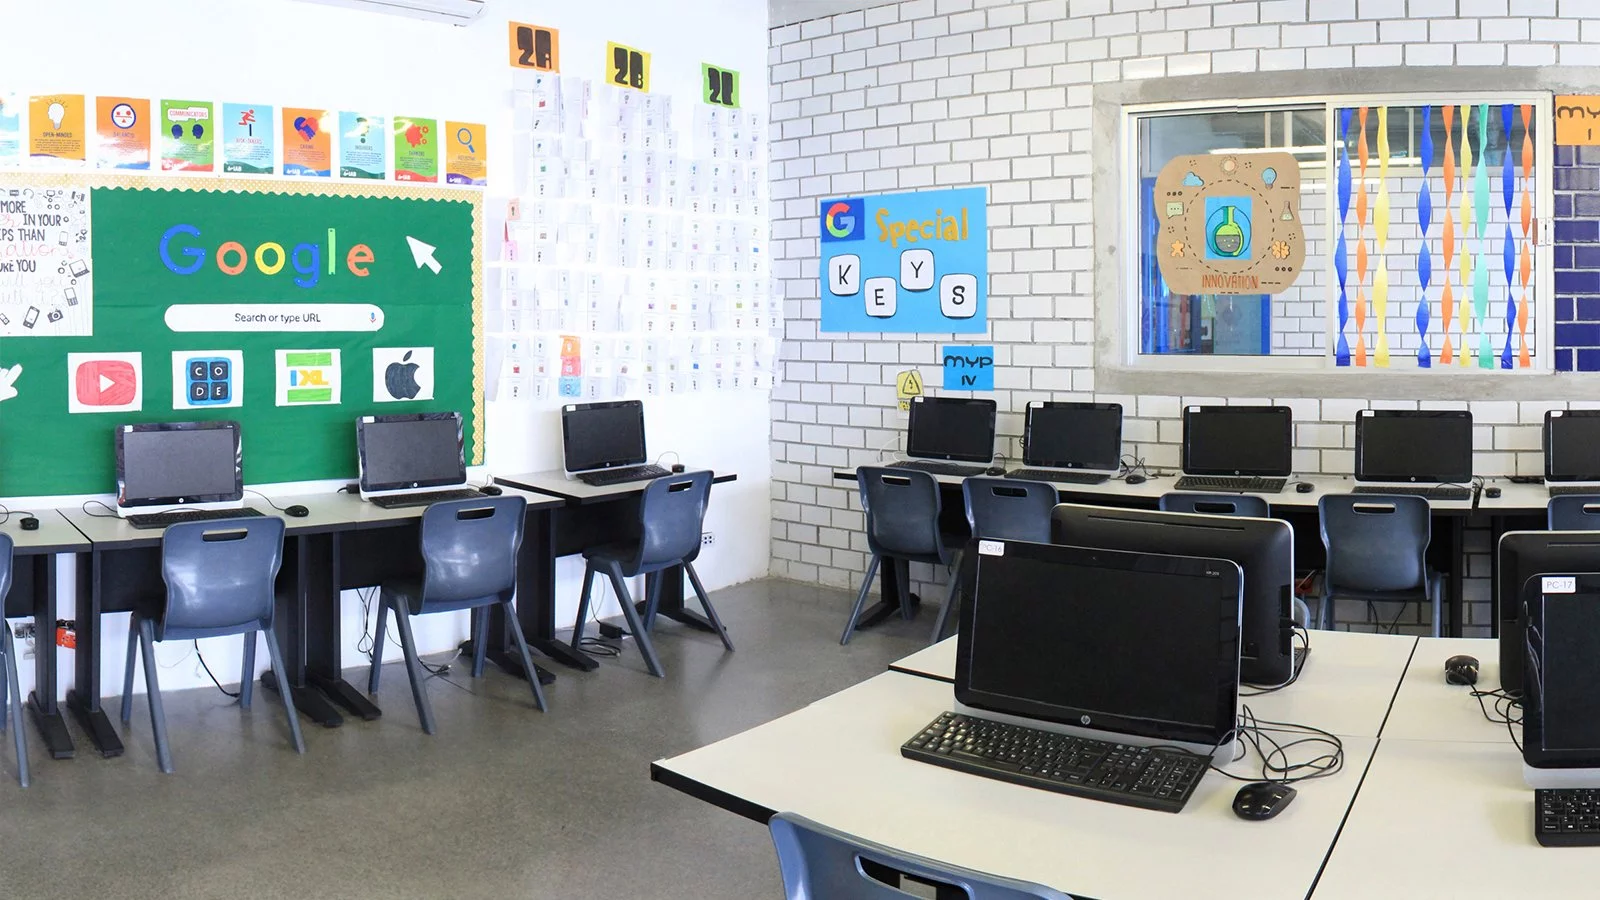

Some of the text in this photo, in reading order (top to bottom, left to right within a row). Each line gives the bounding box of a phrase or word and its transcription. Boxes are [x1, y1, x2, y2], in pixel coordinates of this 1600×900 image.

[517, 26, 551, 69] 2A
[614, 47, 643, 89] 2B
[0, 201, 26, 213] MORE
[23, 214, 36, 226] IN
[37, 214, 61, 227] YOUR
[826, 202, 855, 238] G
[875, 207, 968, 248] Special
[18, 228, 45, 241] THAN
[159, 223, 375, 288] Google
[16, 259, 36, 272] YOU
[839, 261, 965, 305] KEYS
[1202, 274, 1259, 289] INNOVATION
[235, 313, 321, 324] Search or type URL
[290, 369, 329, 386] IXL
[961, 374, 977, 386] IV
[1546, 580, 1573, 589] PC-17
